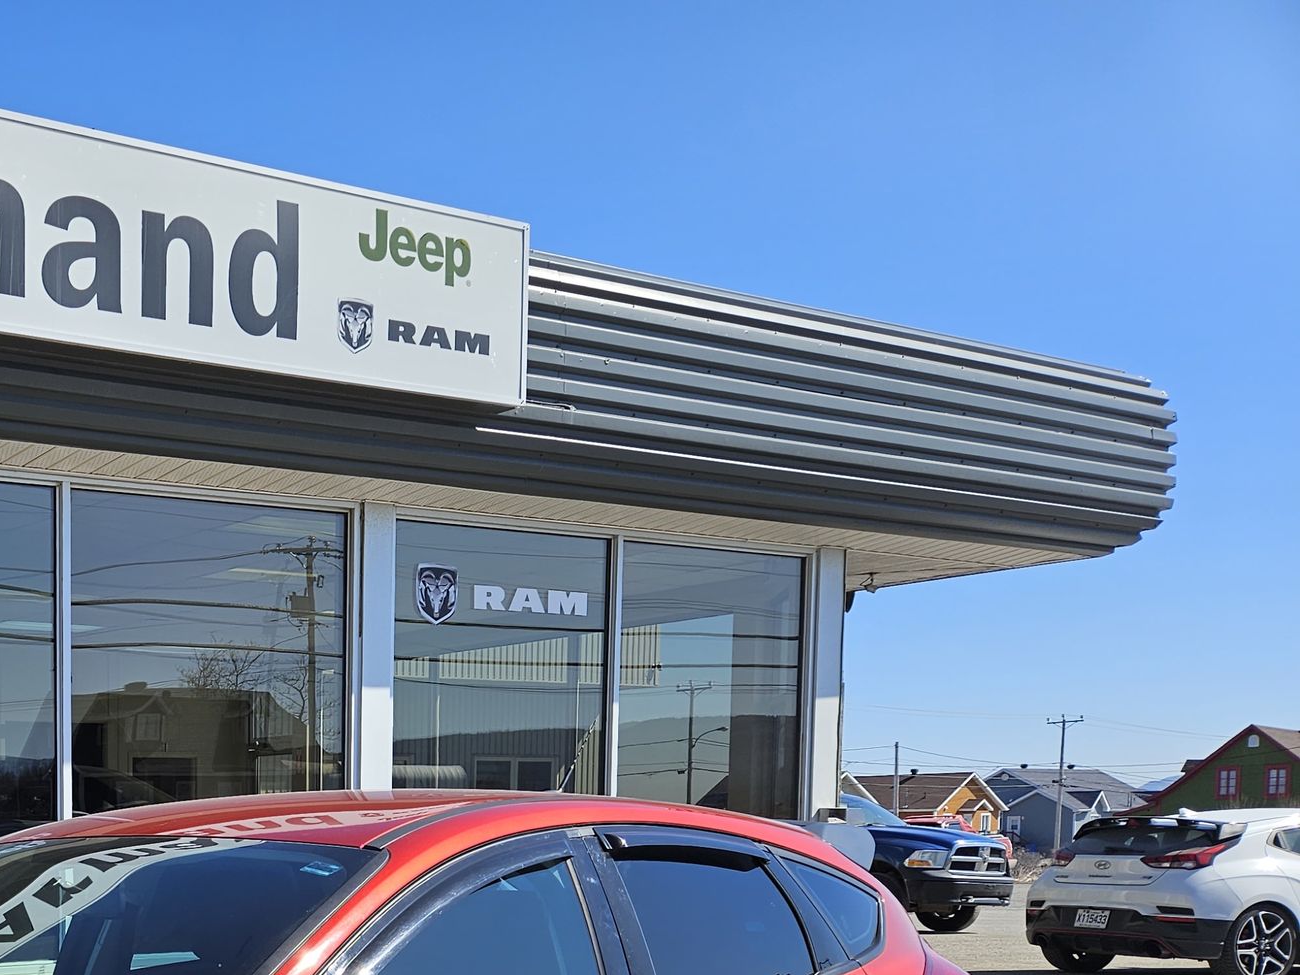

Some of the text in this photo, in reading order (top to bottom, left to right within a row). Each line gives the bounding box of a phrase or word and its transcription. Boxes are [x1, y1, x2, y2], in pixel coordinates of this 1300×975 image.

[358, 208, 472, 287] Jeep
[387, 319, 490, 356] RAM
[473, 584, 588, 617] RAM
